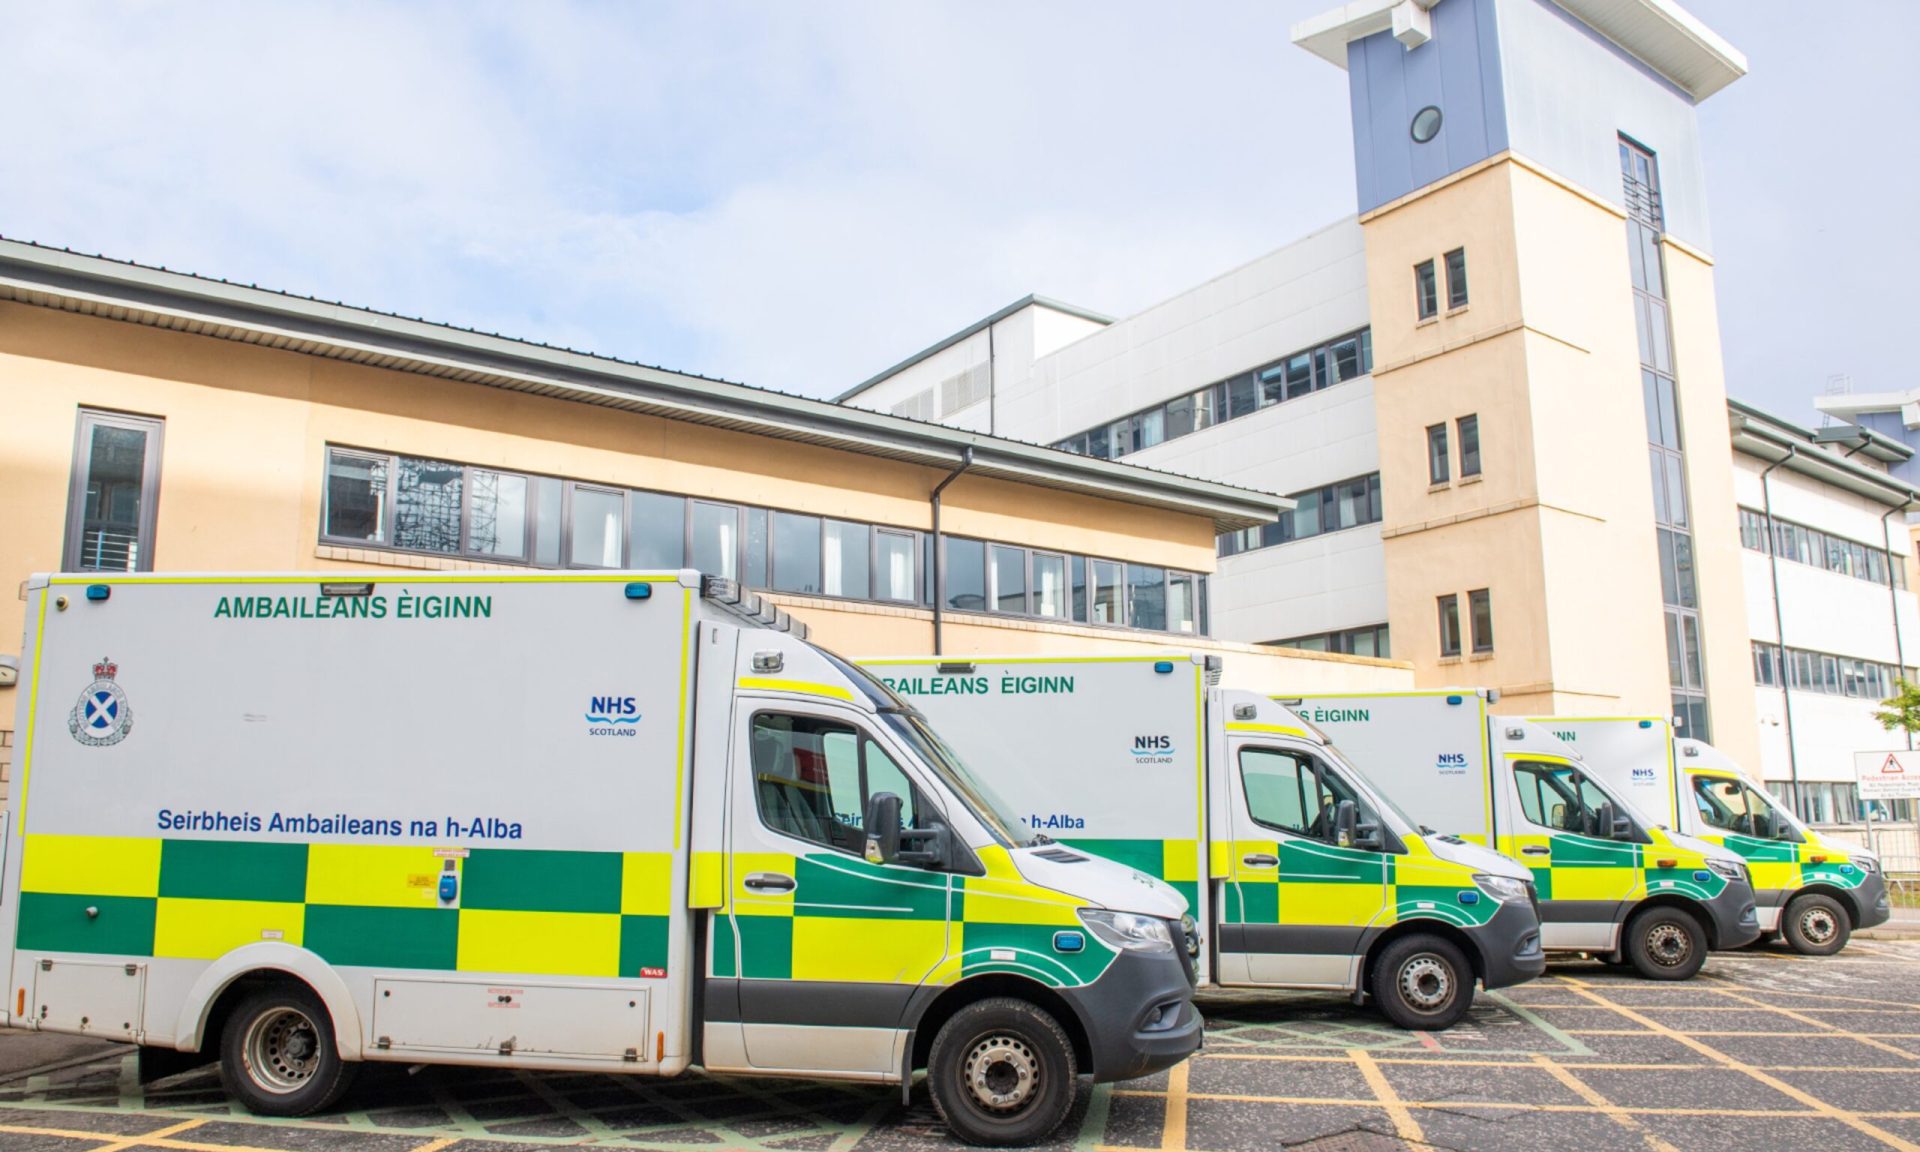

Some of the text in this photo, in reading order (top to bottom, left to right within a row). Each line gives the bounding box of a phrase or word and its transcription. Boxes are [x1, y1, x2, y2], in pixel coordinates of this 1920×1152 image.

[214, 589, 492, 619] AMBAILEANS ÈIGINN
[591, 696, 636, 714] NHS
[589, 728, 636, 737] SCOTLAND
[1135, 735, 1170, 749] NHS
[1438, 753, 1465, 763] NHS
[1632, 768, 1654, 777] NHS
[157, 809, 522, 839] Seirbheis Ambaileans na h-Alba
[1031, 814, 1084, 829] h-Alba
